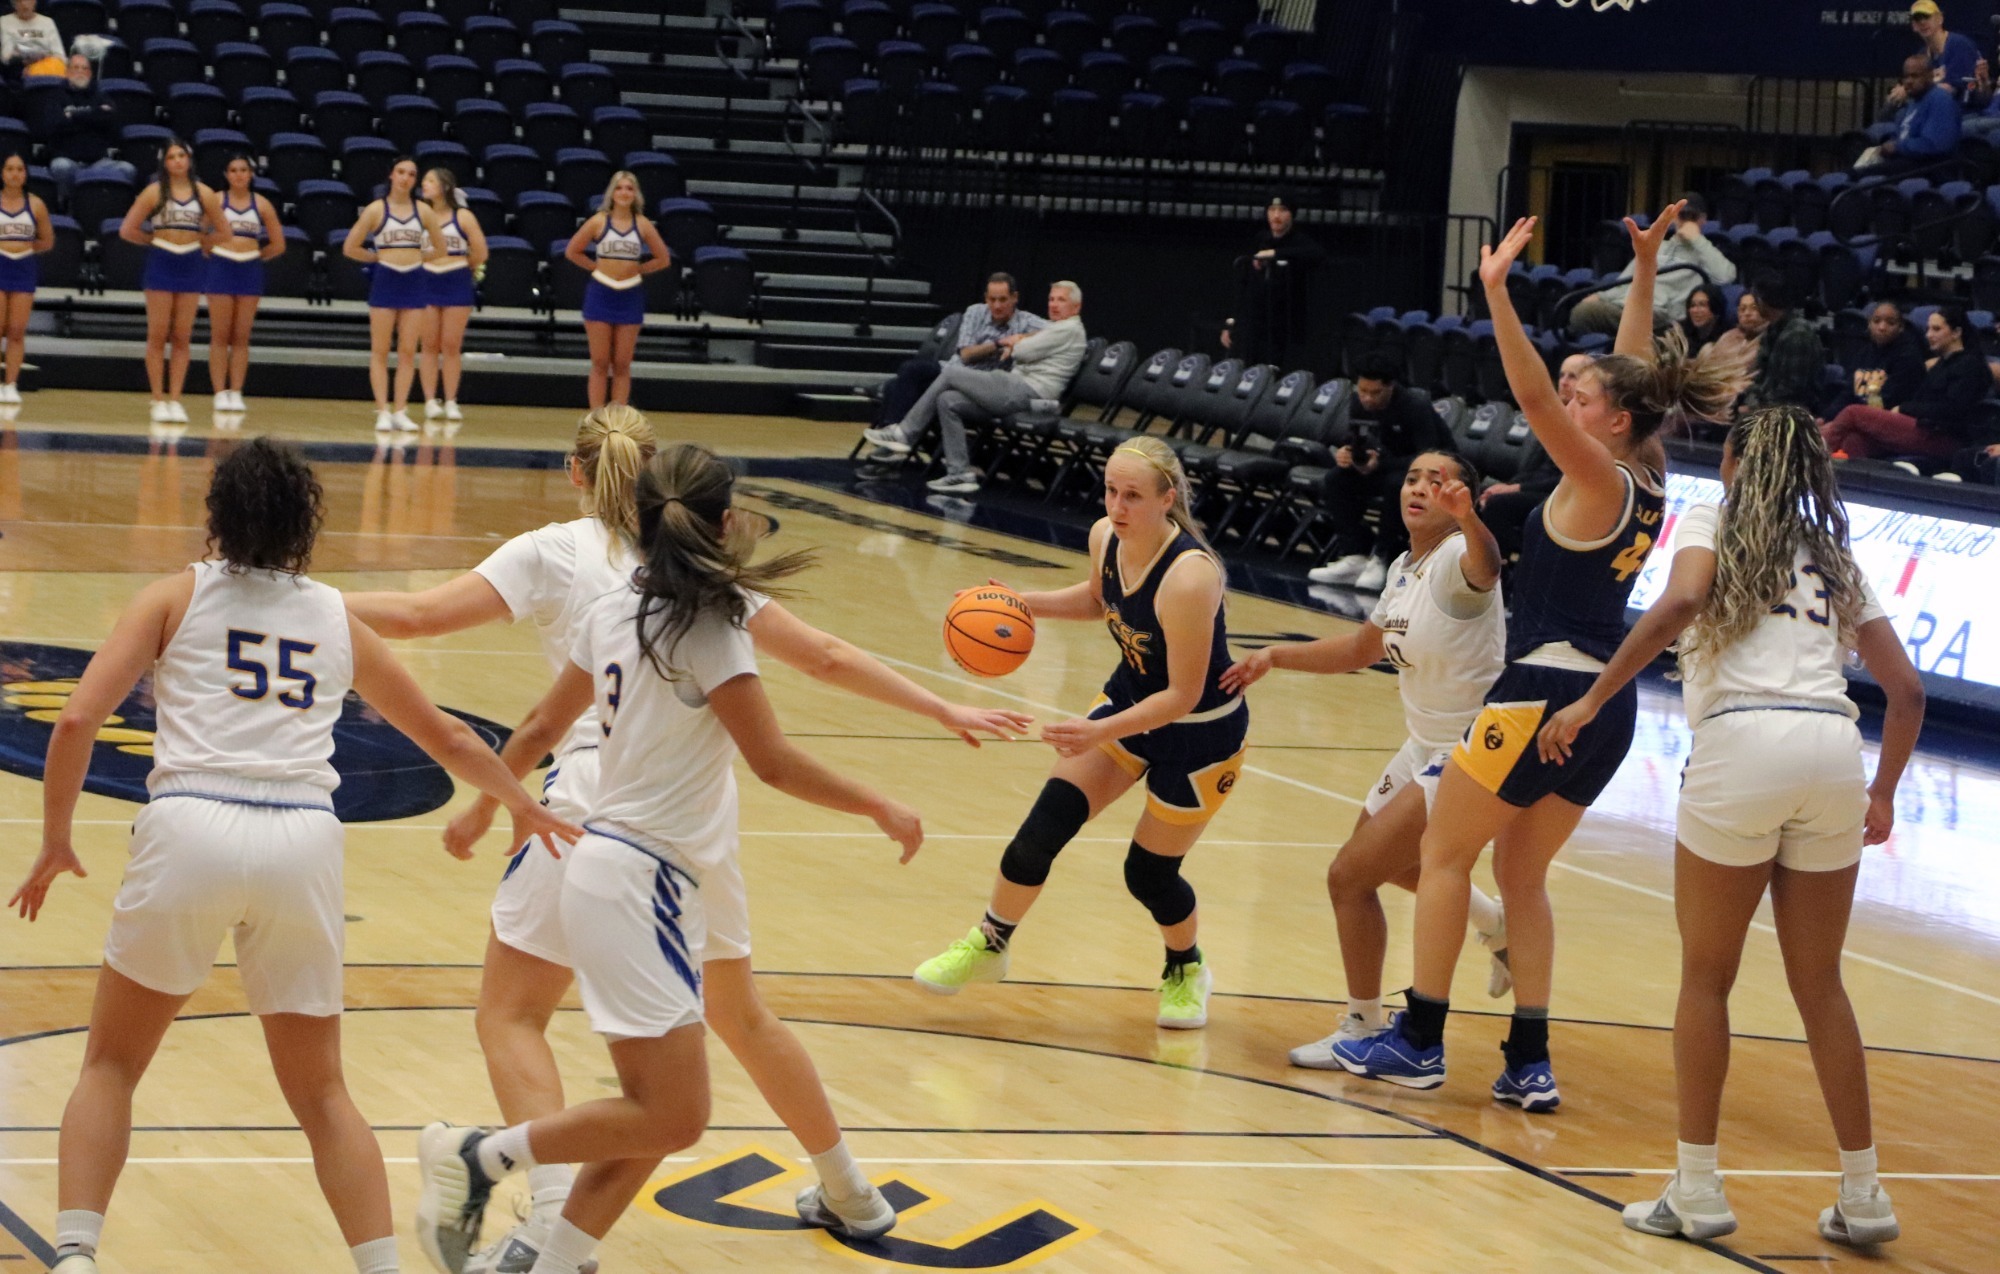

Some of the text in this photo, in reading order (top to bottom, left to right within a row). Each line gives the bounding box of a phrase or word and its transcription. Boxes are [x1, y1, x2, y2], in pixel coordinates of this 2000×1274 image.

[230, 221, 260, 235] CSB
[1850, 509, 1996, 557] Michelob
[976, 592, 1032, 620] Wilson
[226, 627, 318, 712] 55
[1905, 609, 1972, 680] RA
[602, 661, 623, 739] 3
